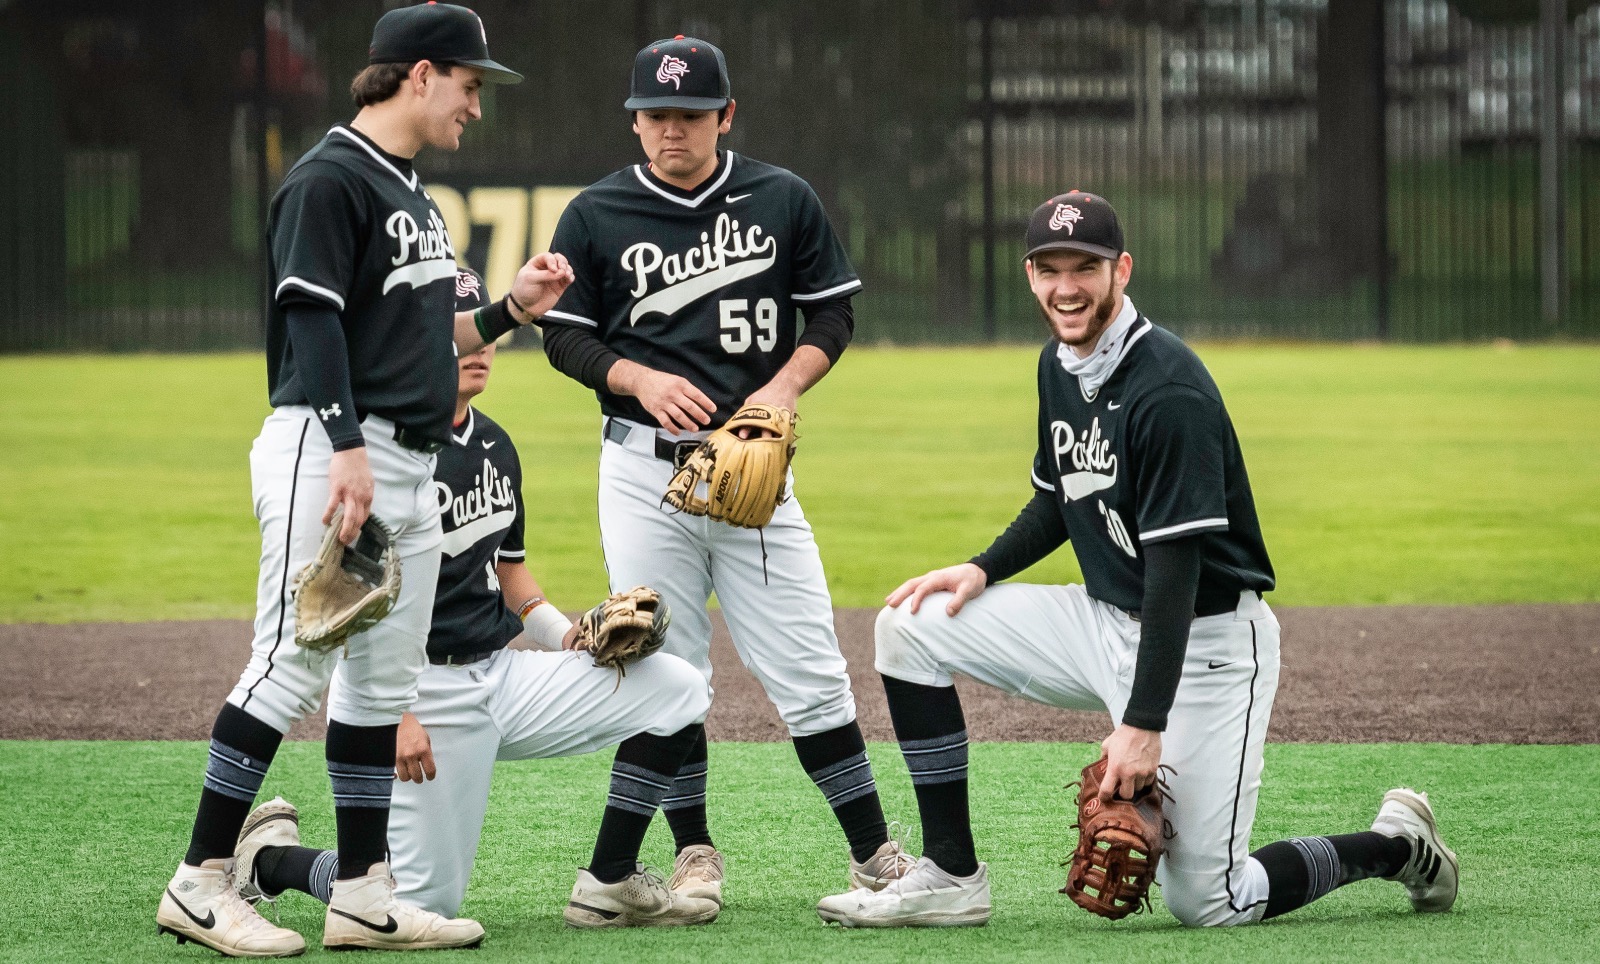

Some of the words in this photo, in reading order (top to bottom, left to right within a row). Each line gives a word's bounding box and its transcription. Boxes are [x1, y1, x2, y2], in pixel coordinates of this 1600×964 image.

[385, 208, 456, 267] Pacifi
[620, 212, 776, 298] Pacific
[719, 297, 778, 354] 59
[1050, 416, 1117, 474] Paific
